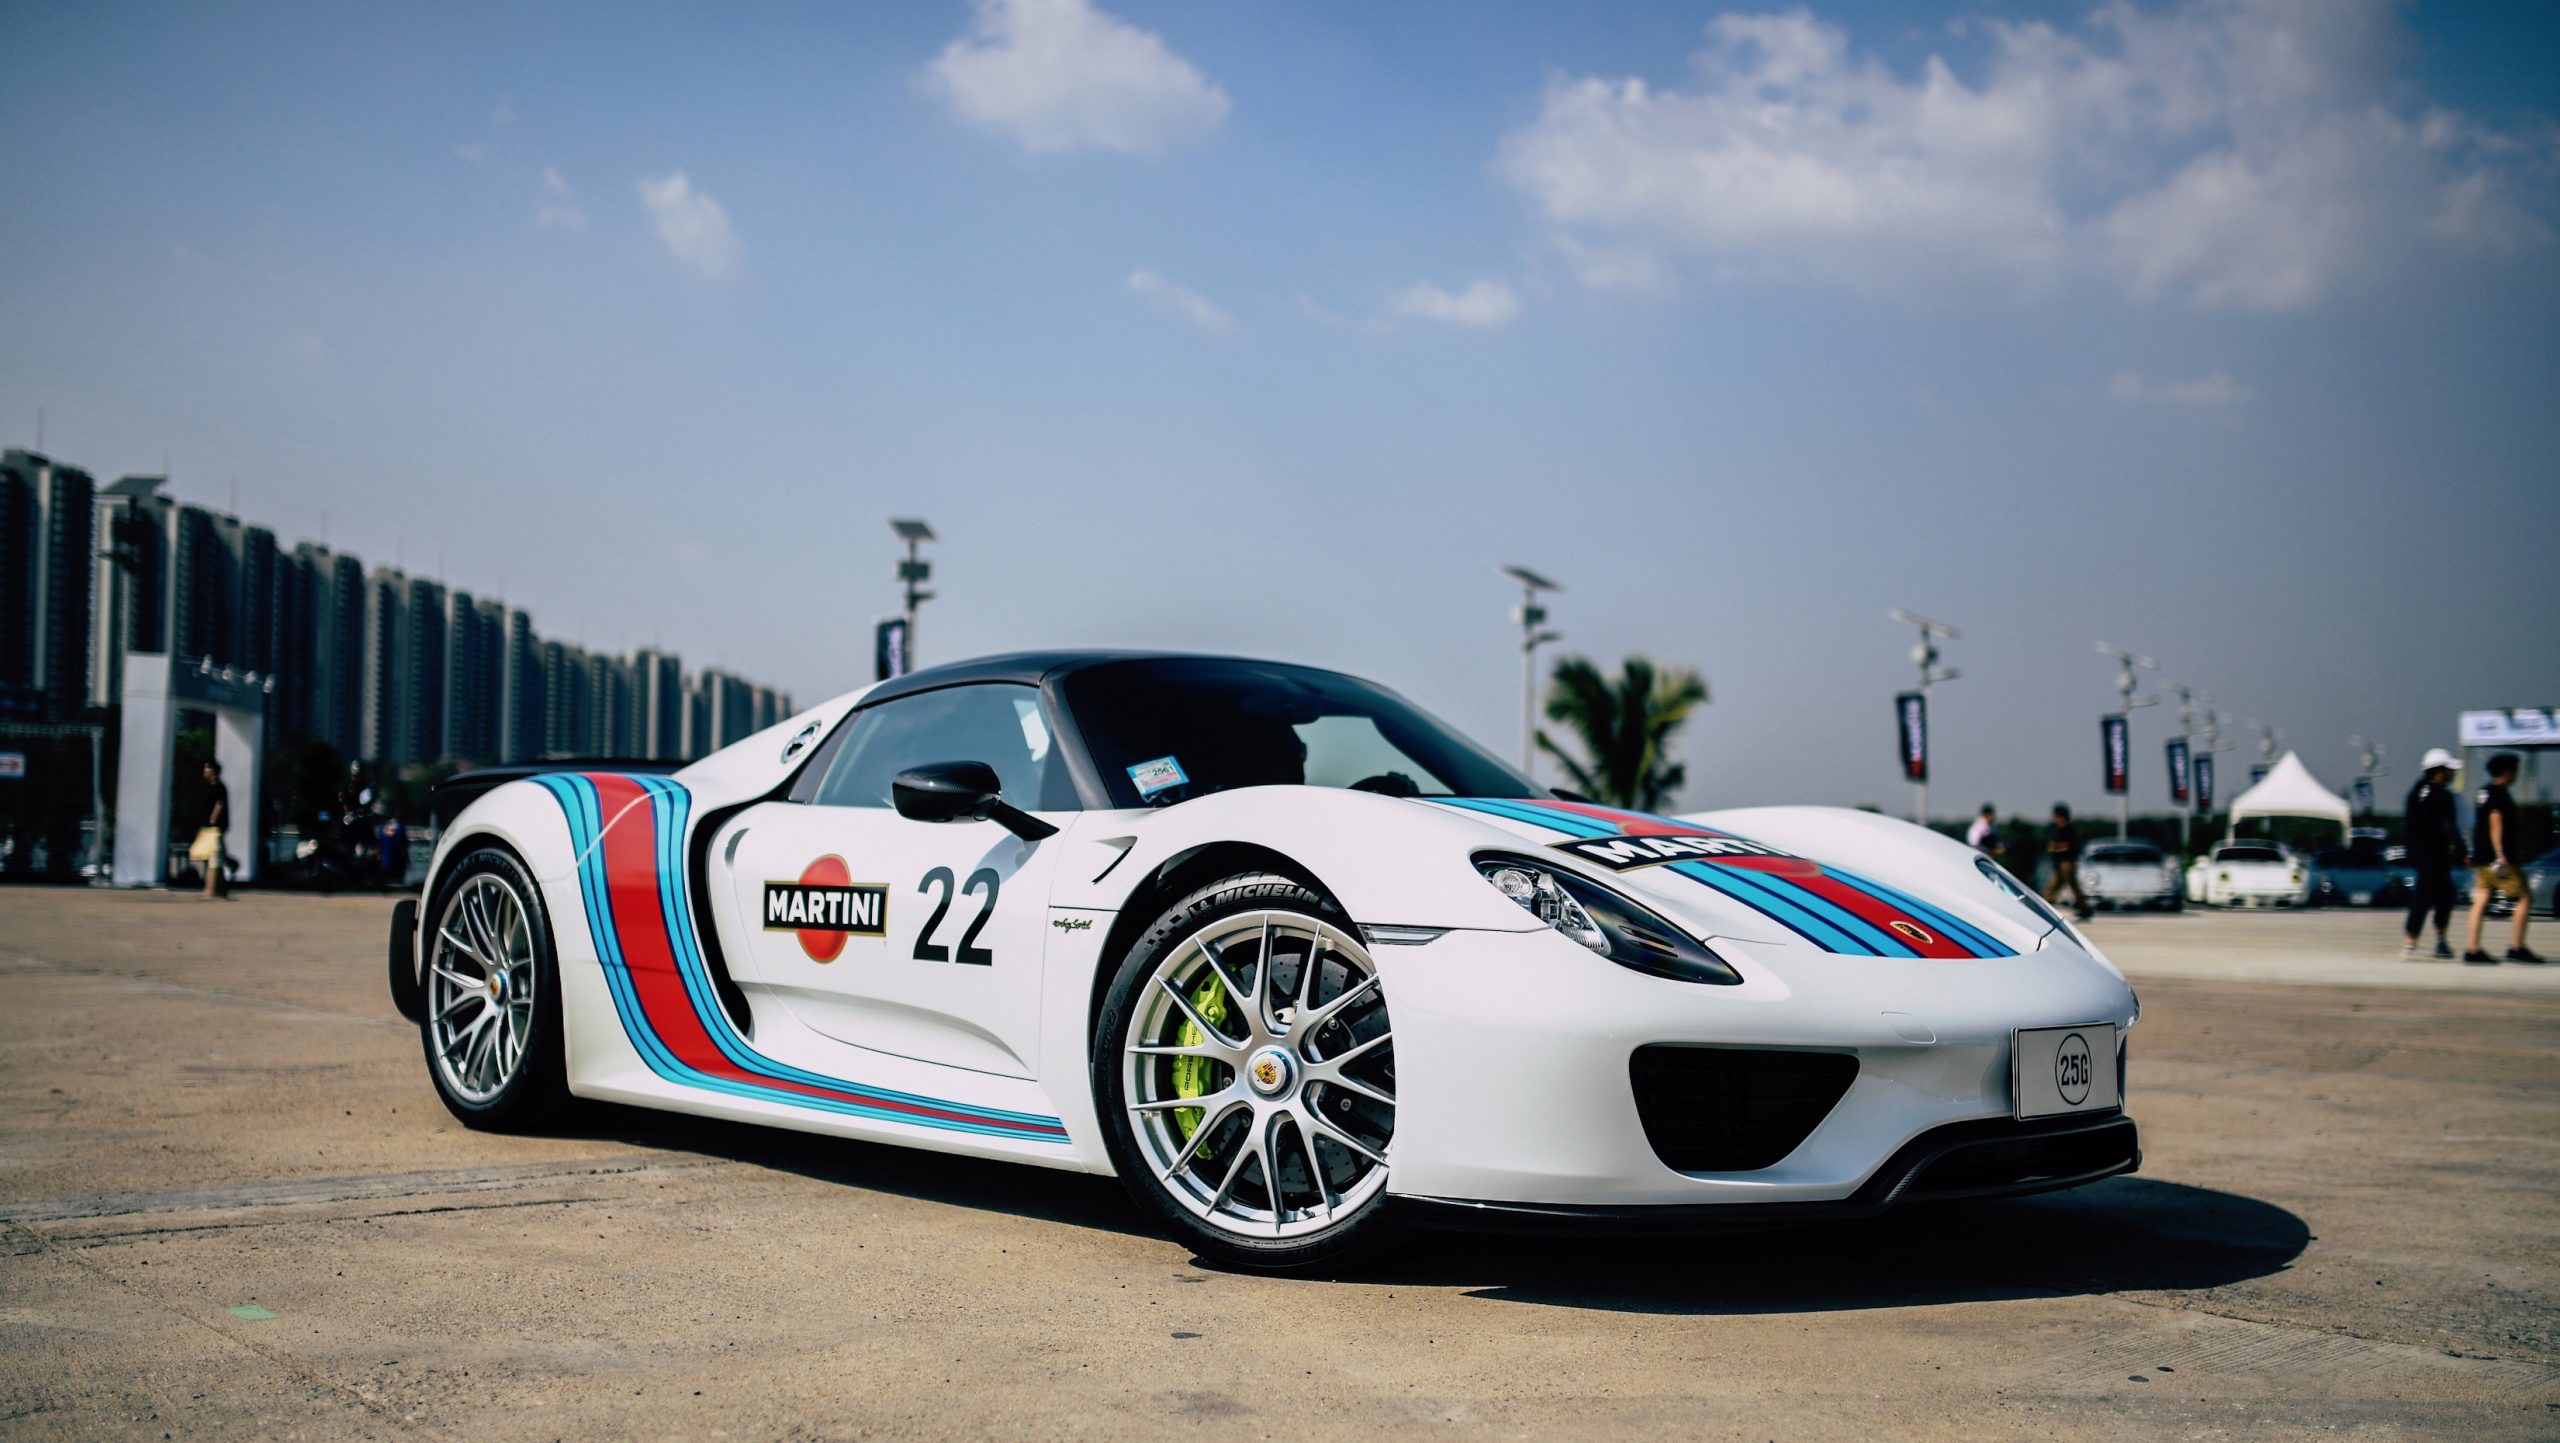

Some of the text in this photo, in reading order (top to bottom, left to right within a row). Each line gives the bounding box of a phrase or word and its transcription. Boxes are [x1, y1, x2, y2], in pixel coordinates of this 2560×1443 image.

[1577, 836, 1792, 864] MARTI
[768, 889, 880, 926] MARTINI
[1214, 884, 1320, 906] MICHELIN
[912, 866, 1001, 967] 22
[1184, 1026, 1198, 1091] PORSHE
